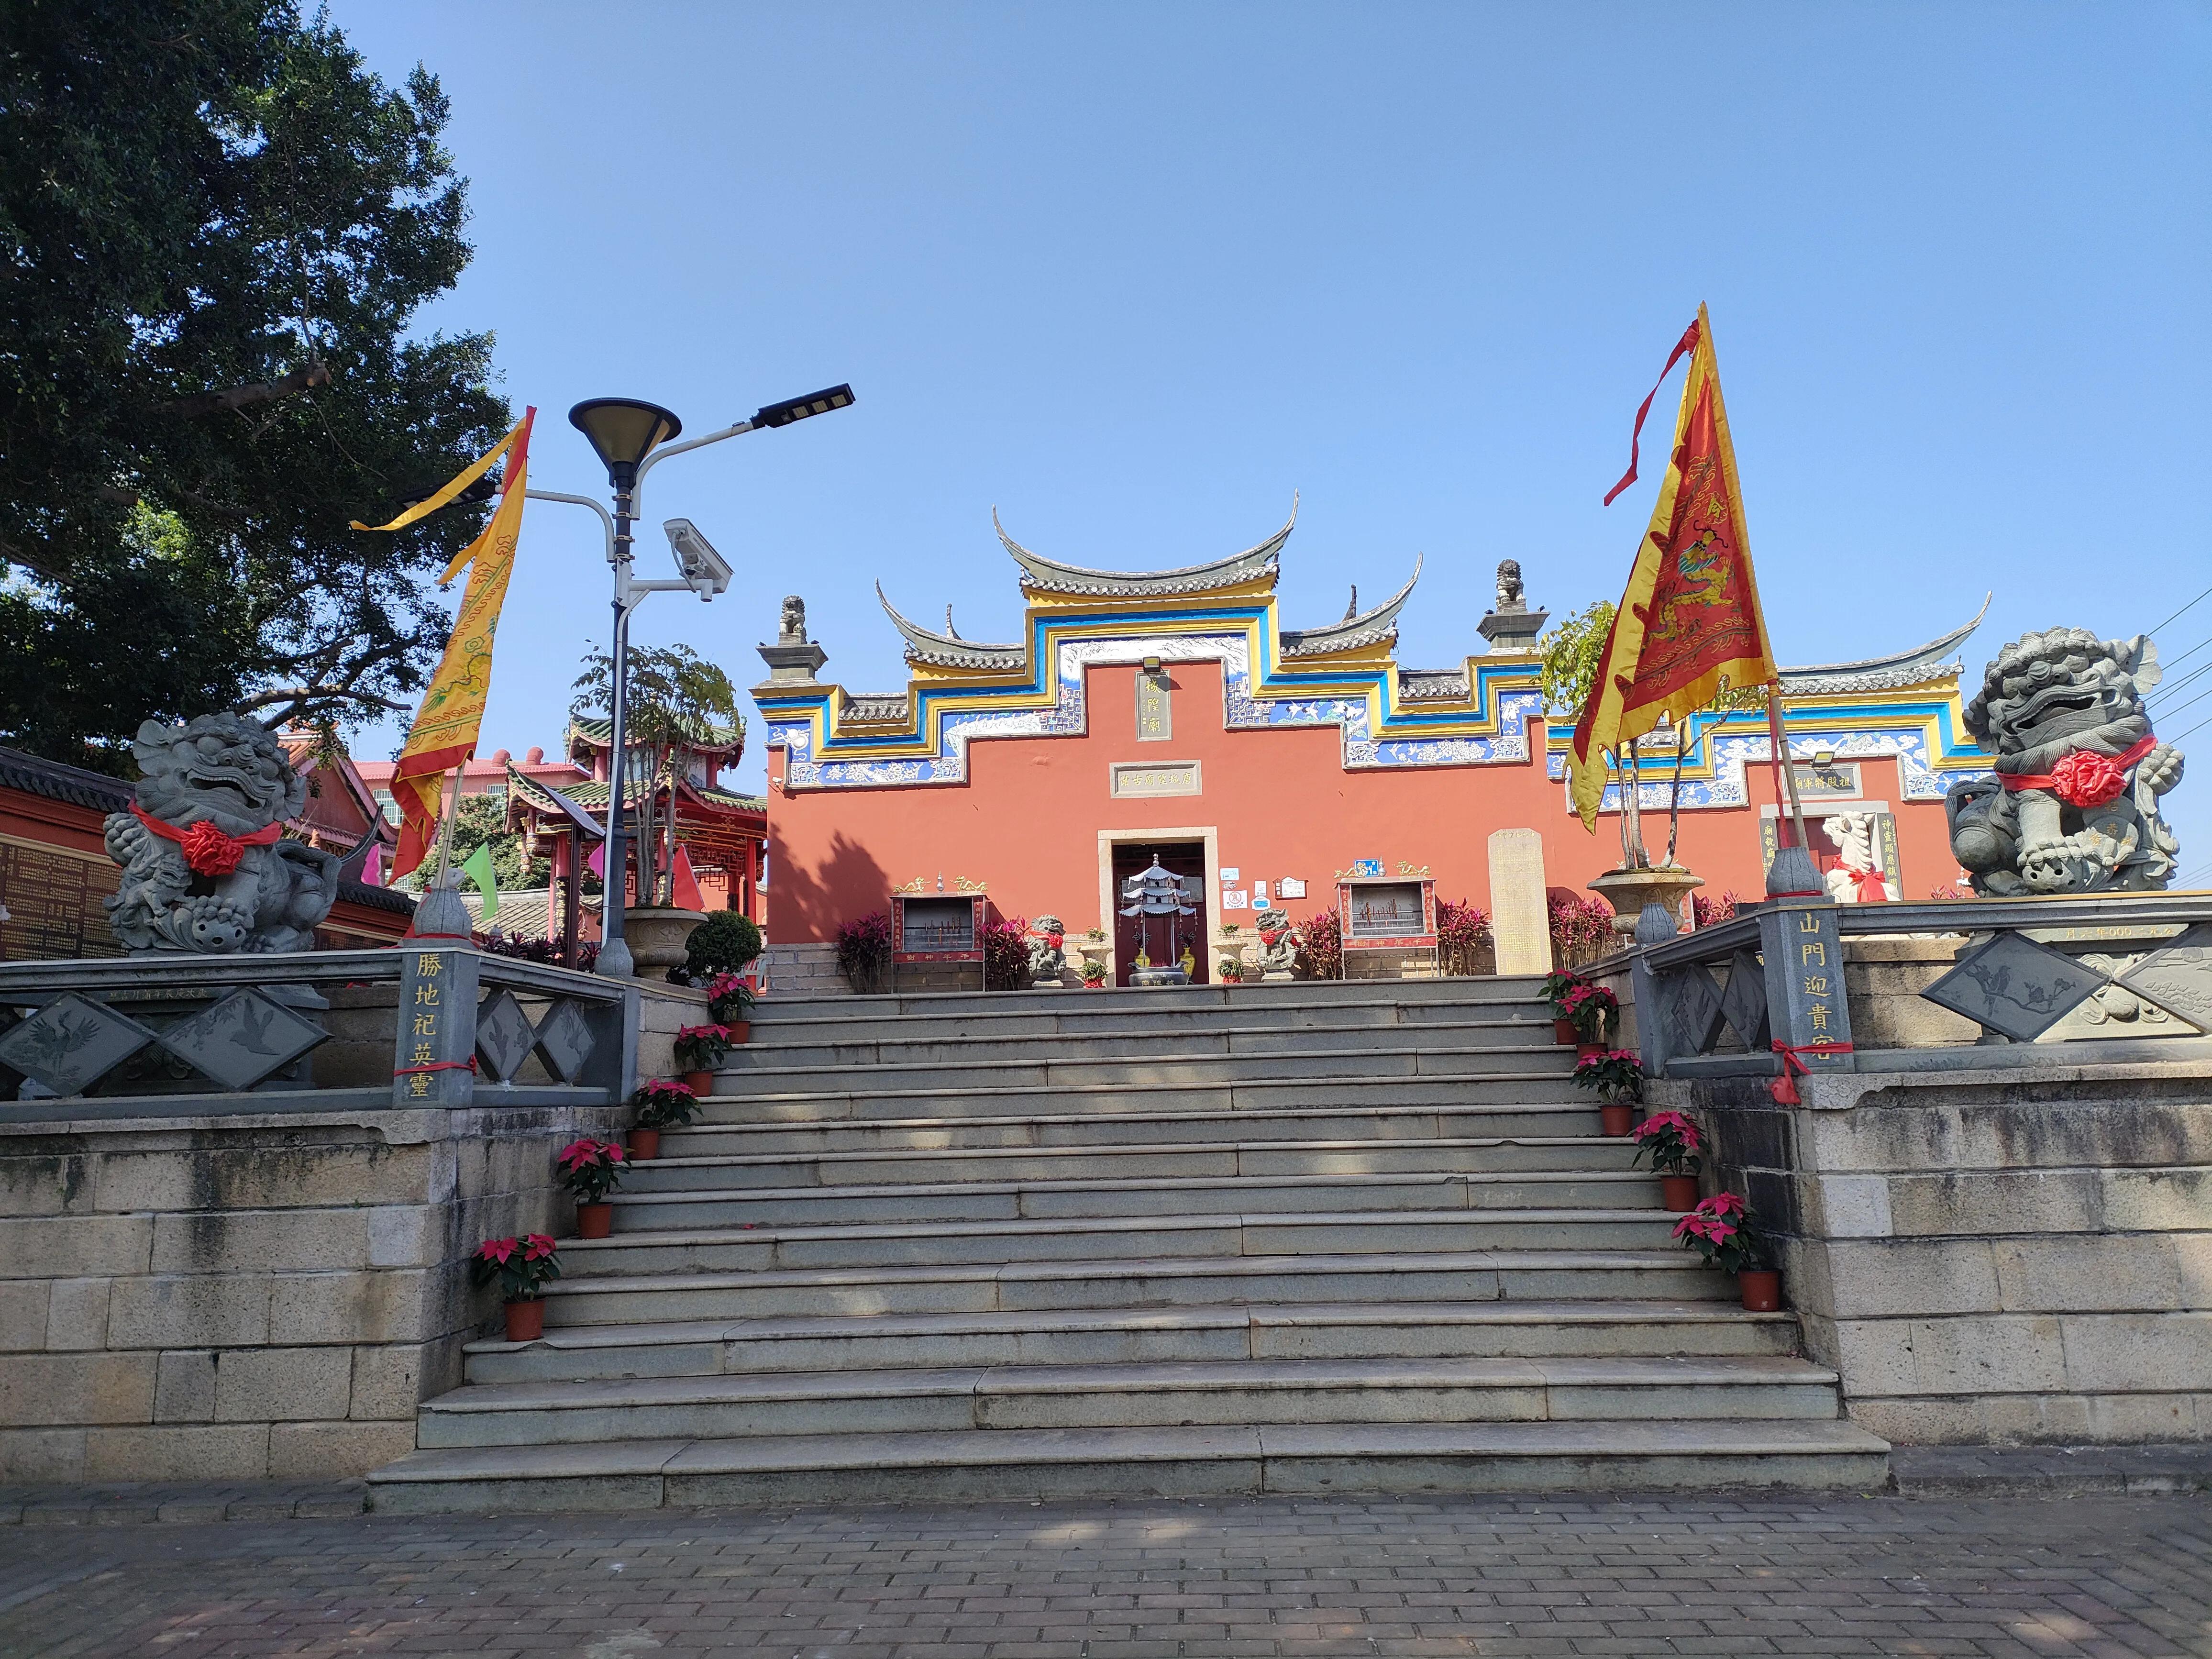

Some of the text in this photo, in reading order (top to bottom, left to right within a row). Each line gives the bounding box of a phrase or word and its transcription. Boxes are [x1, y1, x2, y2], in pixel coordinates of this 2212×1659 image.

[1145, 679, 1161, 732] 城隍廟
[409, 954, 443, 1097] 勝地祀英靈
[1800, 911, 1835, 1060] 山門迎貴客
